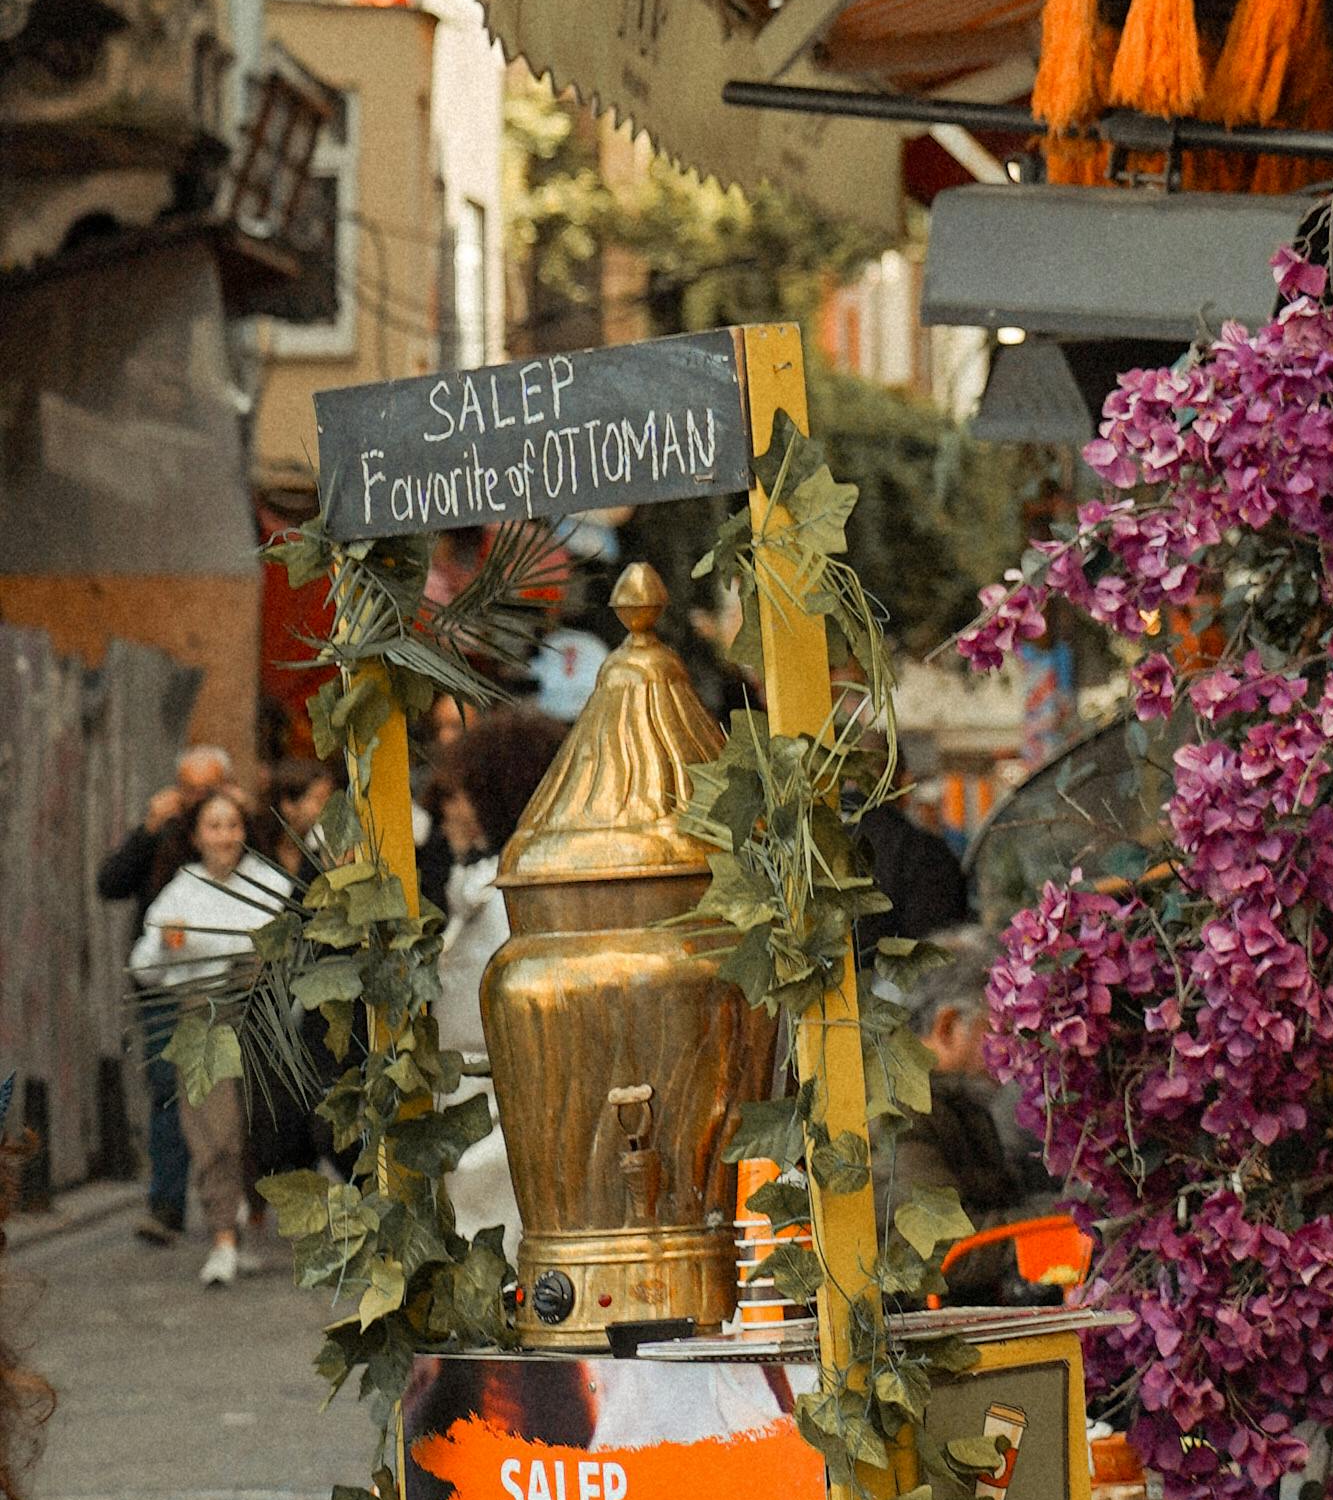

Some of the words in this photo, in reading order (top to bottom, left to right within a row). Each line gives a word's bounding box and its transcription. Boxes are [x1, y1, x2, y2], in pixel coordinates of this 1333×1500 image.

[422, 354, 575, 442] SALEP
[360, 443, 506, 524] Favorite
[505, 438, 535, 520] of
[541, 407, 716, 498] OTTOMAN
